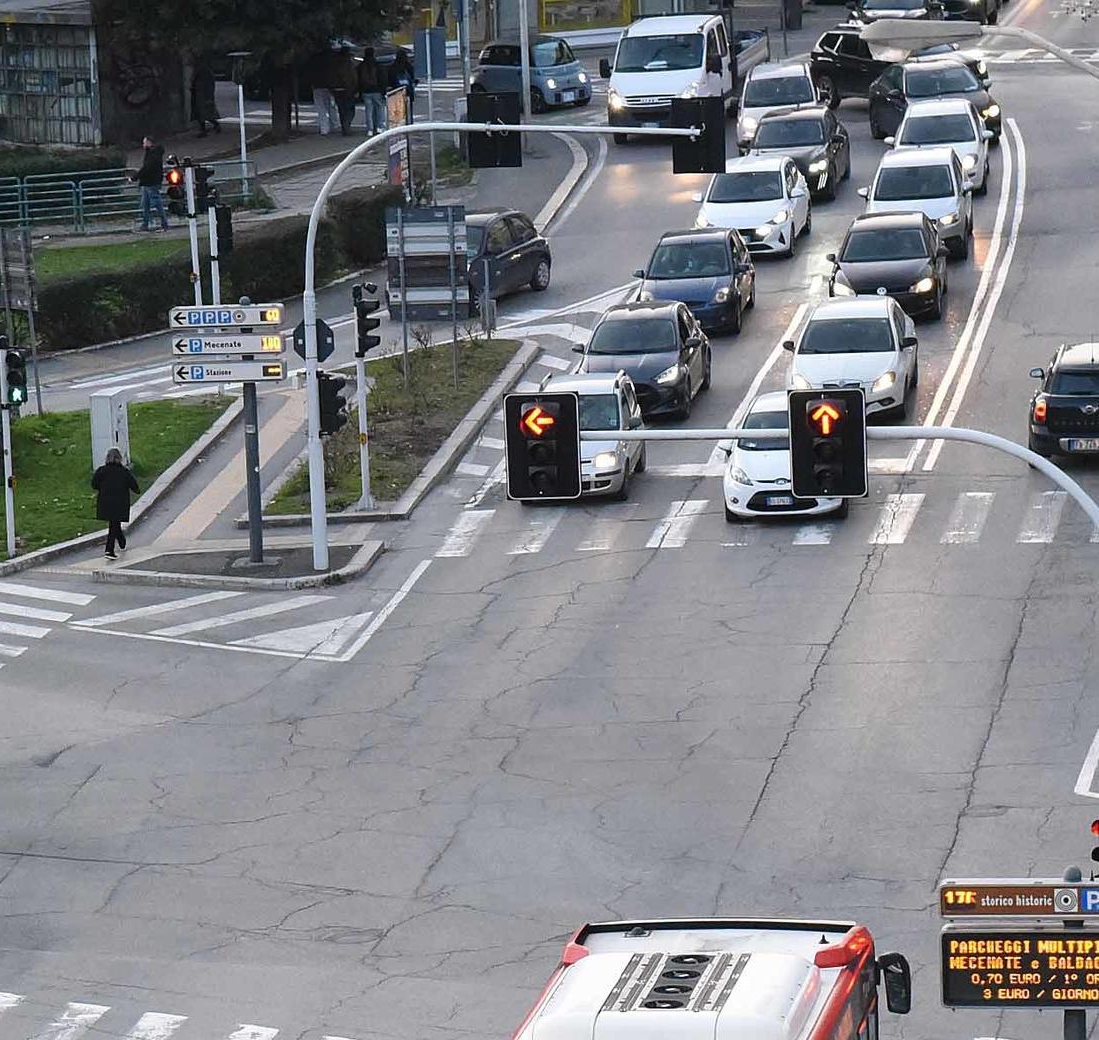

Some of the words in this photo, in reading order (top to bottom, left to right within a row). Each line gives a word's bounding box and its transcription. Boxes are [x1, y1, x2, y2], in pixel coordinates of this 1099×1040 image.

[981, 896, 1013, 906] storico
[1016, 895, 1052, 906] historic
[950, 940, 1030, 953] PARCHEGGI
[950, 957, 1021, 969] MECENATE
[1031, 960, 1040, 969] e
[1009, 974, 1041, 984] EURO
[983, 989, 992, 999] 3
[998, 989, 1030, 999] EURO
